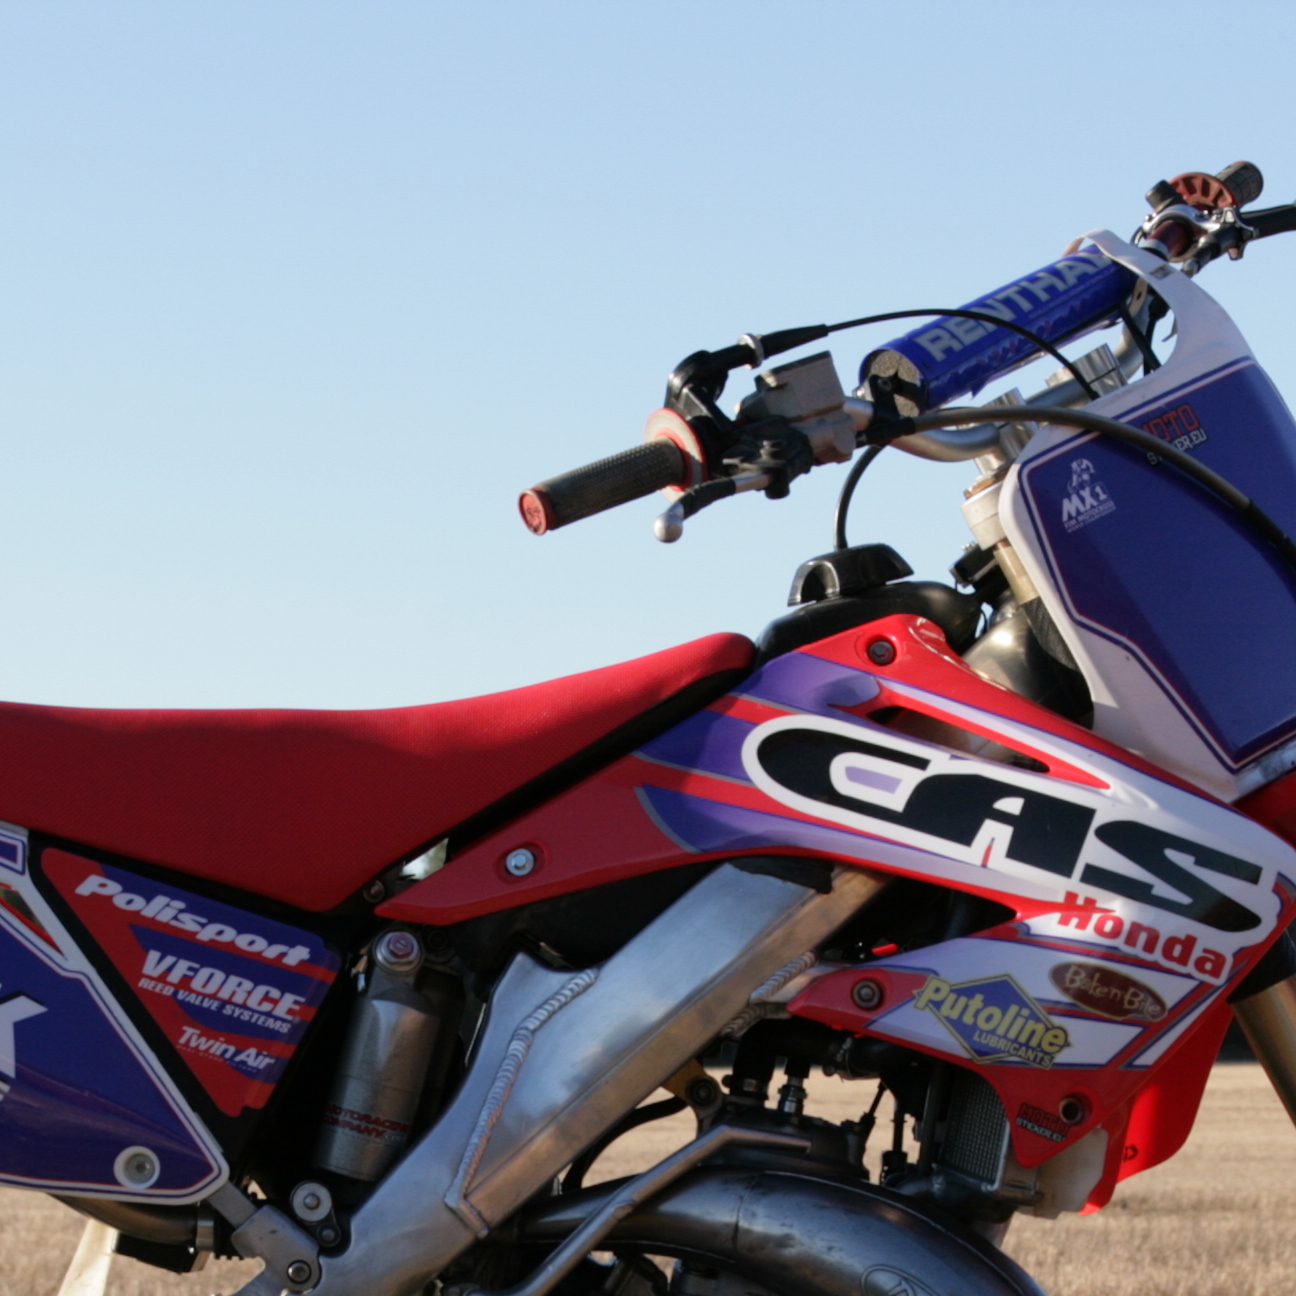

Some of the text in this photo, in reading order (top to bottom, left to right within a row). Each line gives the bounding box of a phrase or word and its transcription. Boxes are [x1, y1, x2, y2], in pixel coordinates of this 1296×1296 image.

[756, 727, 1263, 933] CAS
[74, 873, 311, 967] Polisport
[1056, 890, 1228, 981] Honda
[138, 977, 292, 1034] REED VALVE SYSTEMS
[141, 949, 307, 1021] VFORCE
[914, 977, 1069, 1054] Putoline
[178, 1025, 236, 1059] Twin
[234, 1047, 275, 1070] Air
[973, 1029, 1053, 1068] LUBRICANTS
